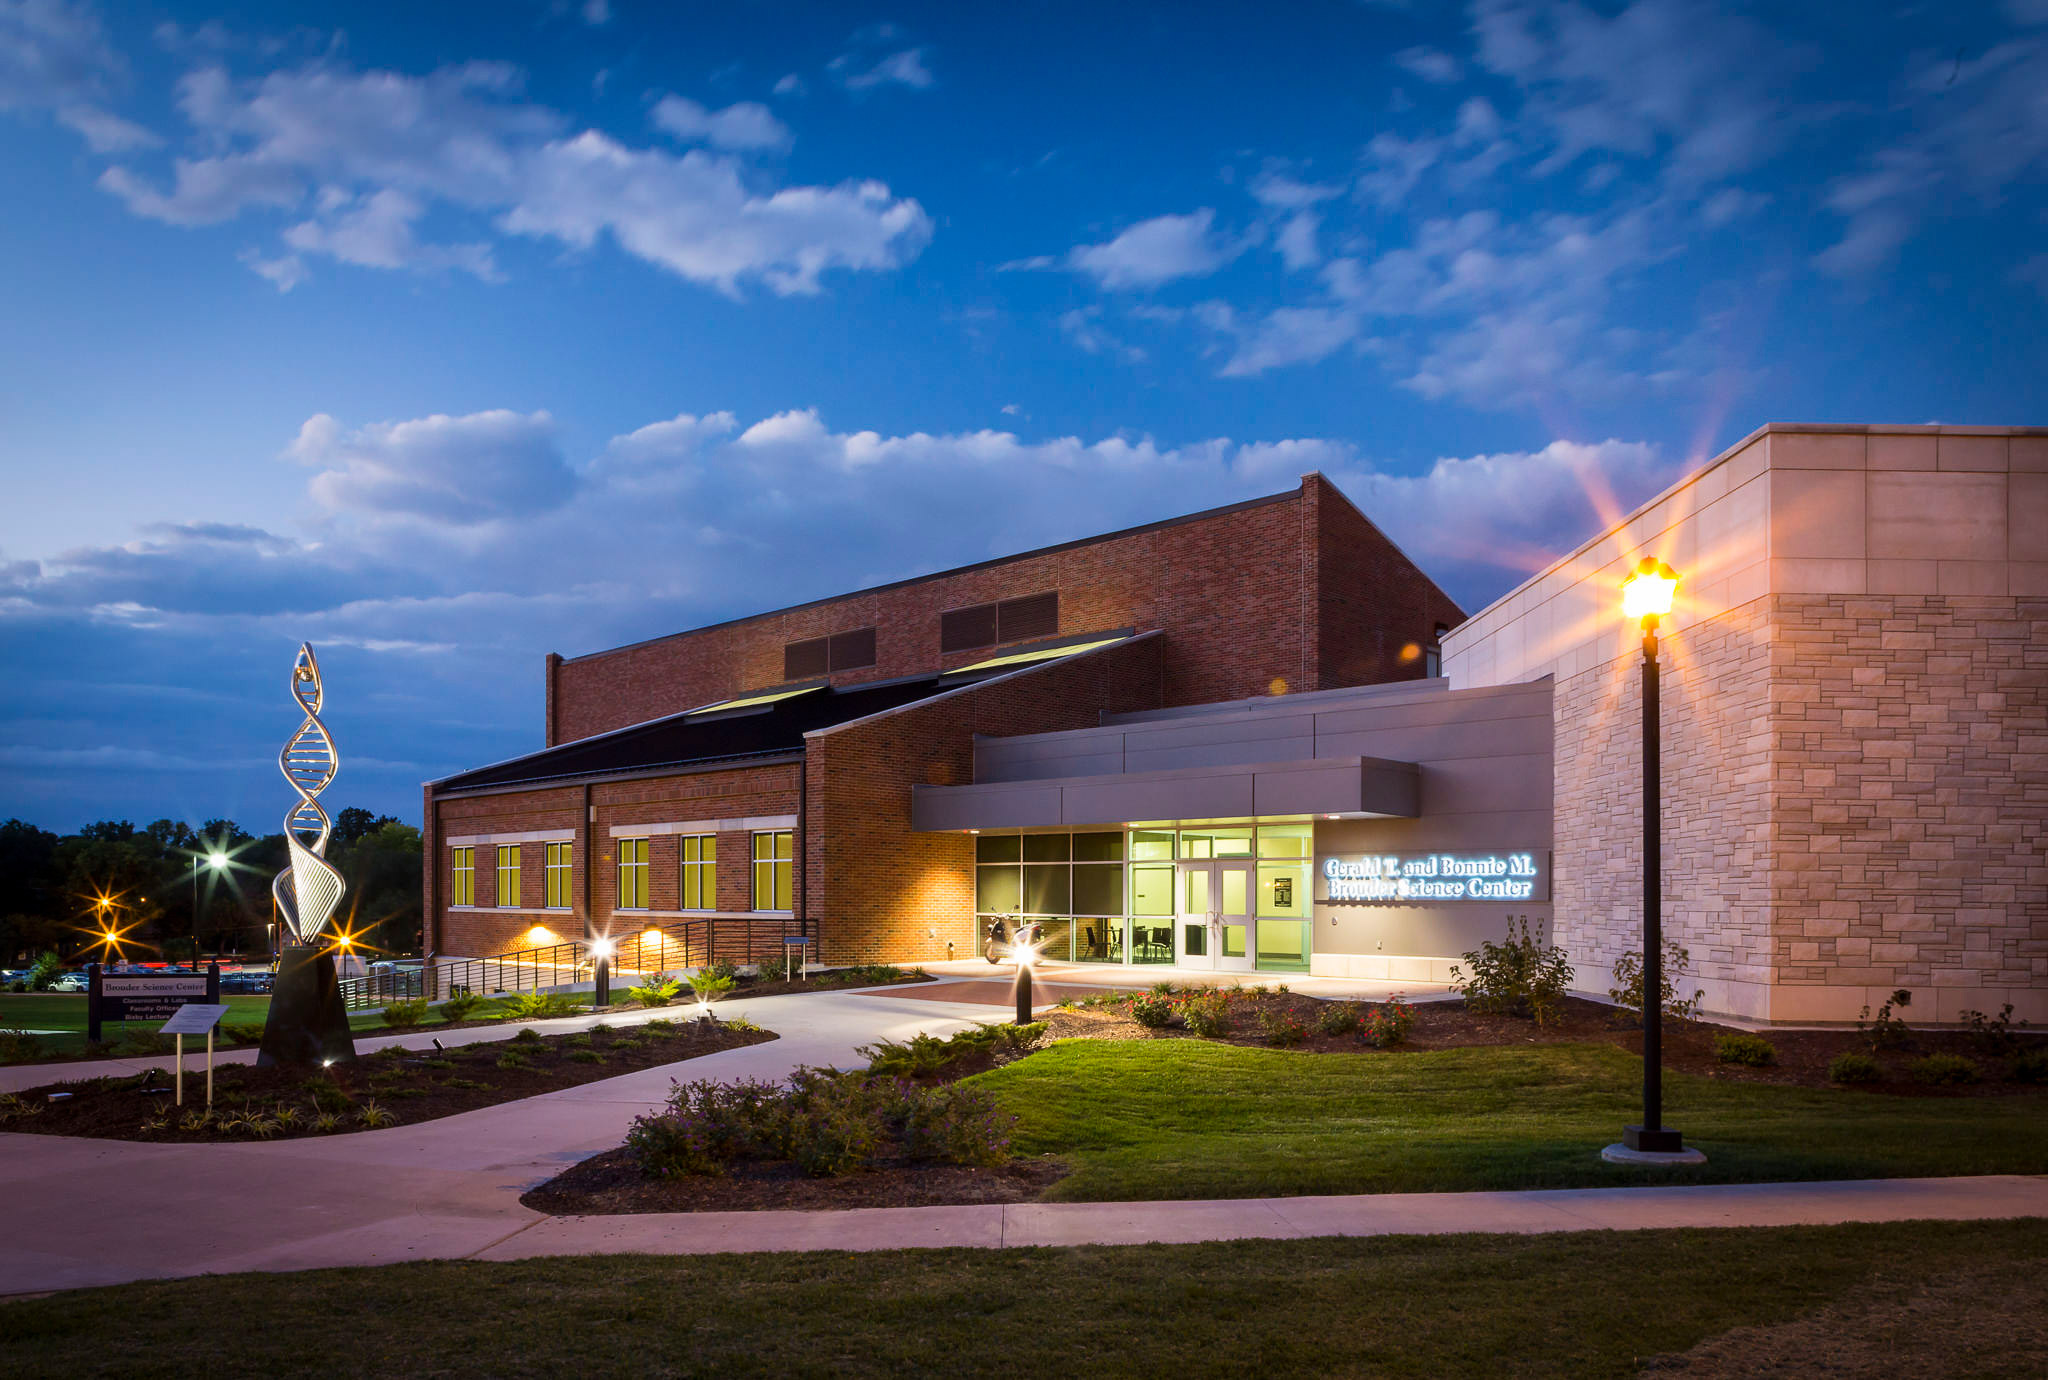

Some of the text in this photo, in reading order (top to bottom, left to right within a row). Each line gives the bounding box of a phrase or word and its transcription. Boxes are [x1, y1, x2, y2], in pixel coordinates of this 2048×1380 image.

[1324, 857, 1381, 877] Gerald
[1403, 856, 1438, 876] and
[1440, 856, 1507, 876] Bonnie
[1508, 855, 1536, 875] M.
[1328, 878, 1532, 897] Brouder Science Center
[176, 983, 204, 991] Center
